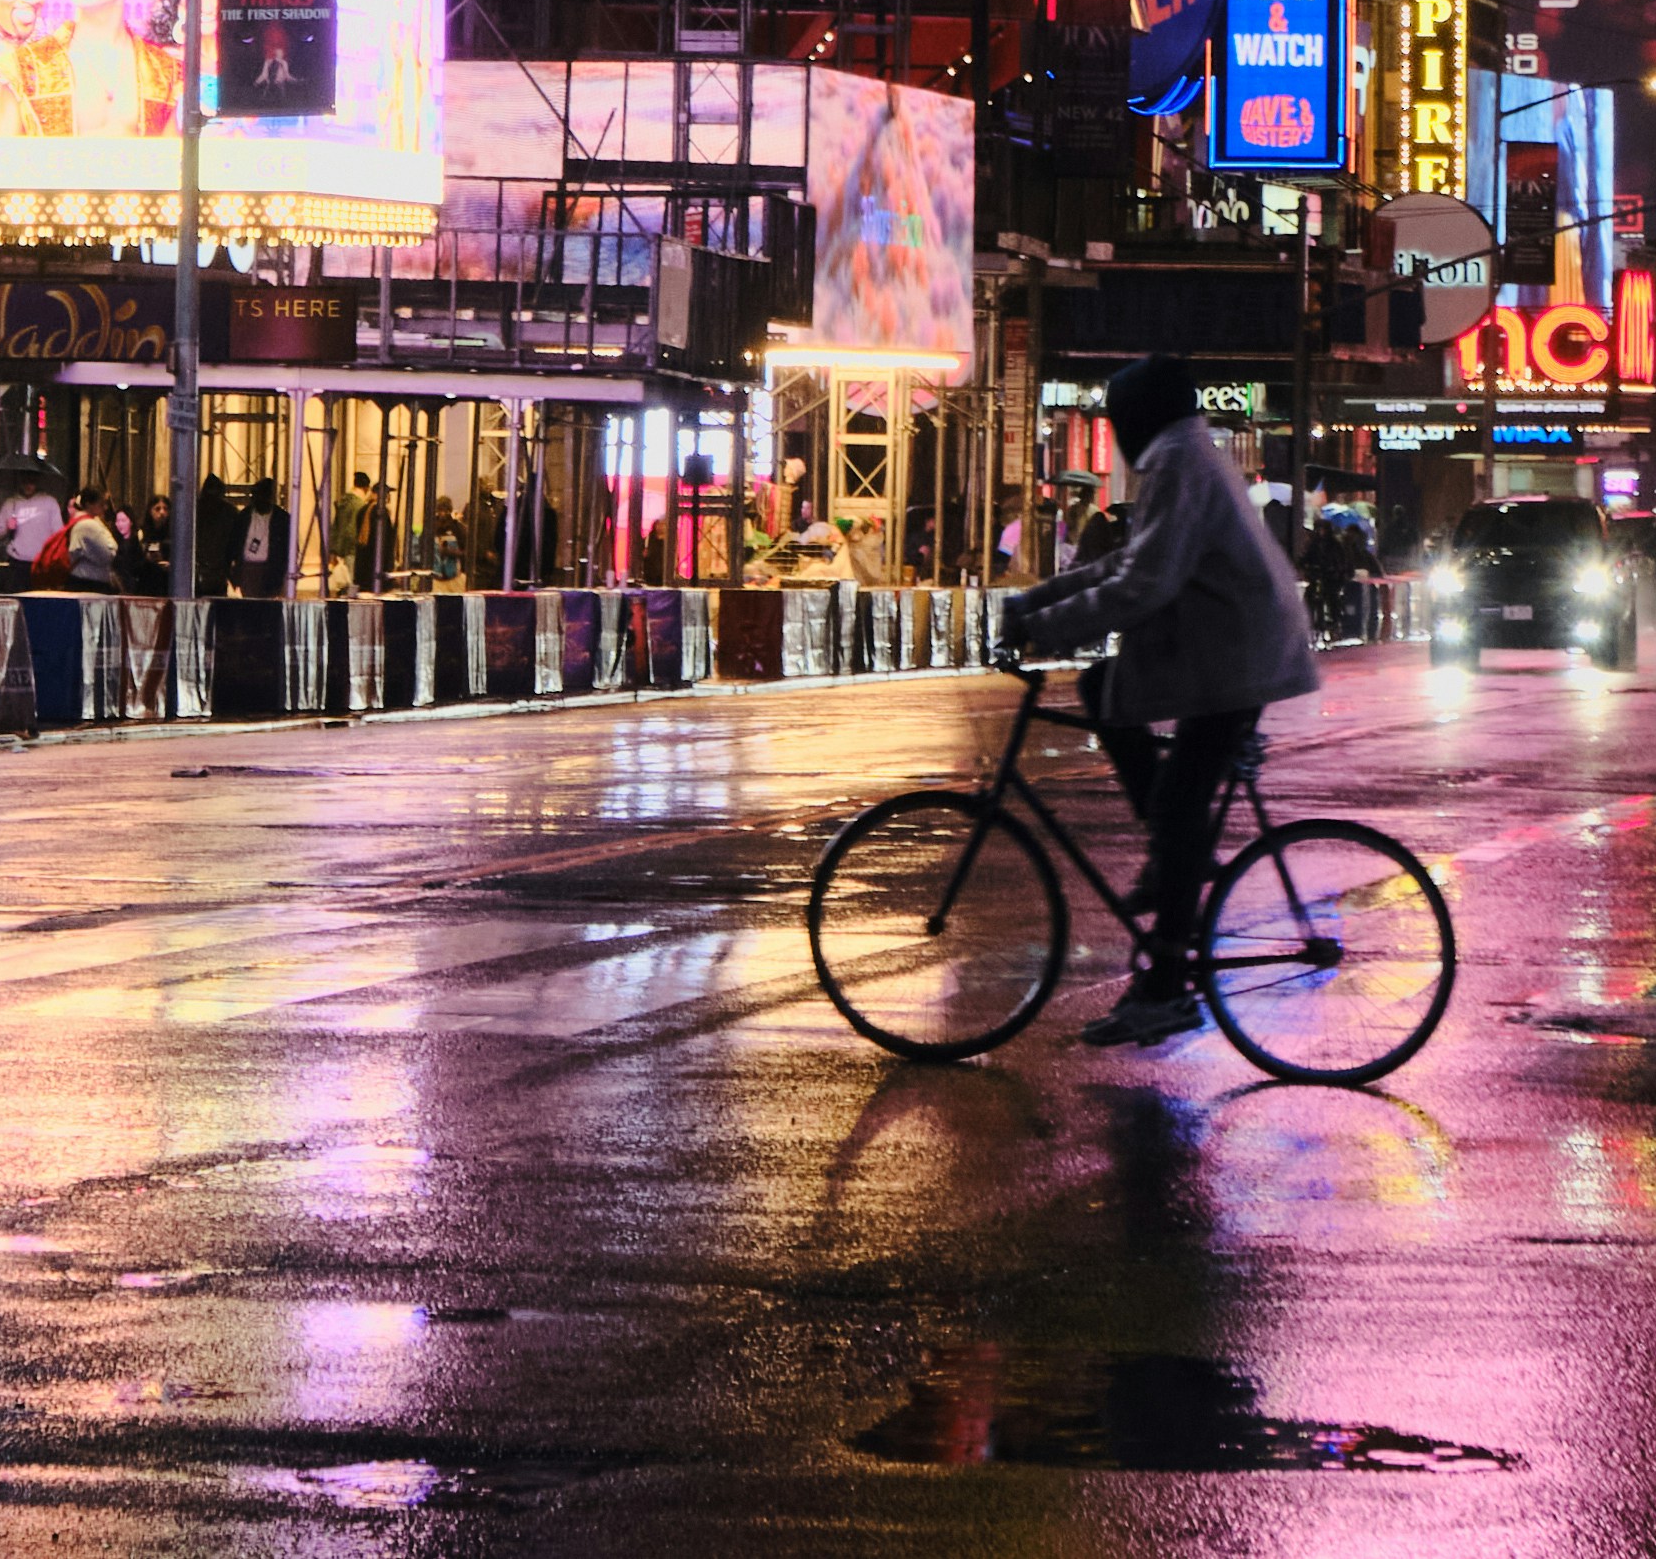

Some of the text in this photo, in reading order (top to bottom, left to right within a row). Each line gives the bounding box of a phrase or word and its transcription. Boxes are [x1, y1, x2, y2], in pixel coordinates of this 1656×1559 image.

[221, 8, 332, 21] THE FIRST SHADOW
[1268, 1, 1290, 33] &
[1233, 32, 1325, 68] WATCH
[274, 299, 342, 319] HERE
